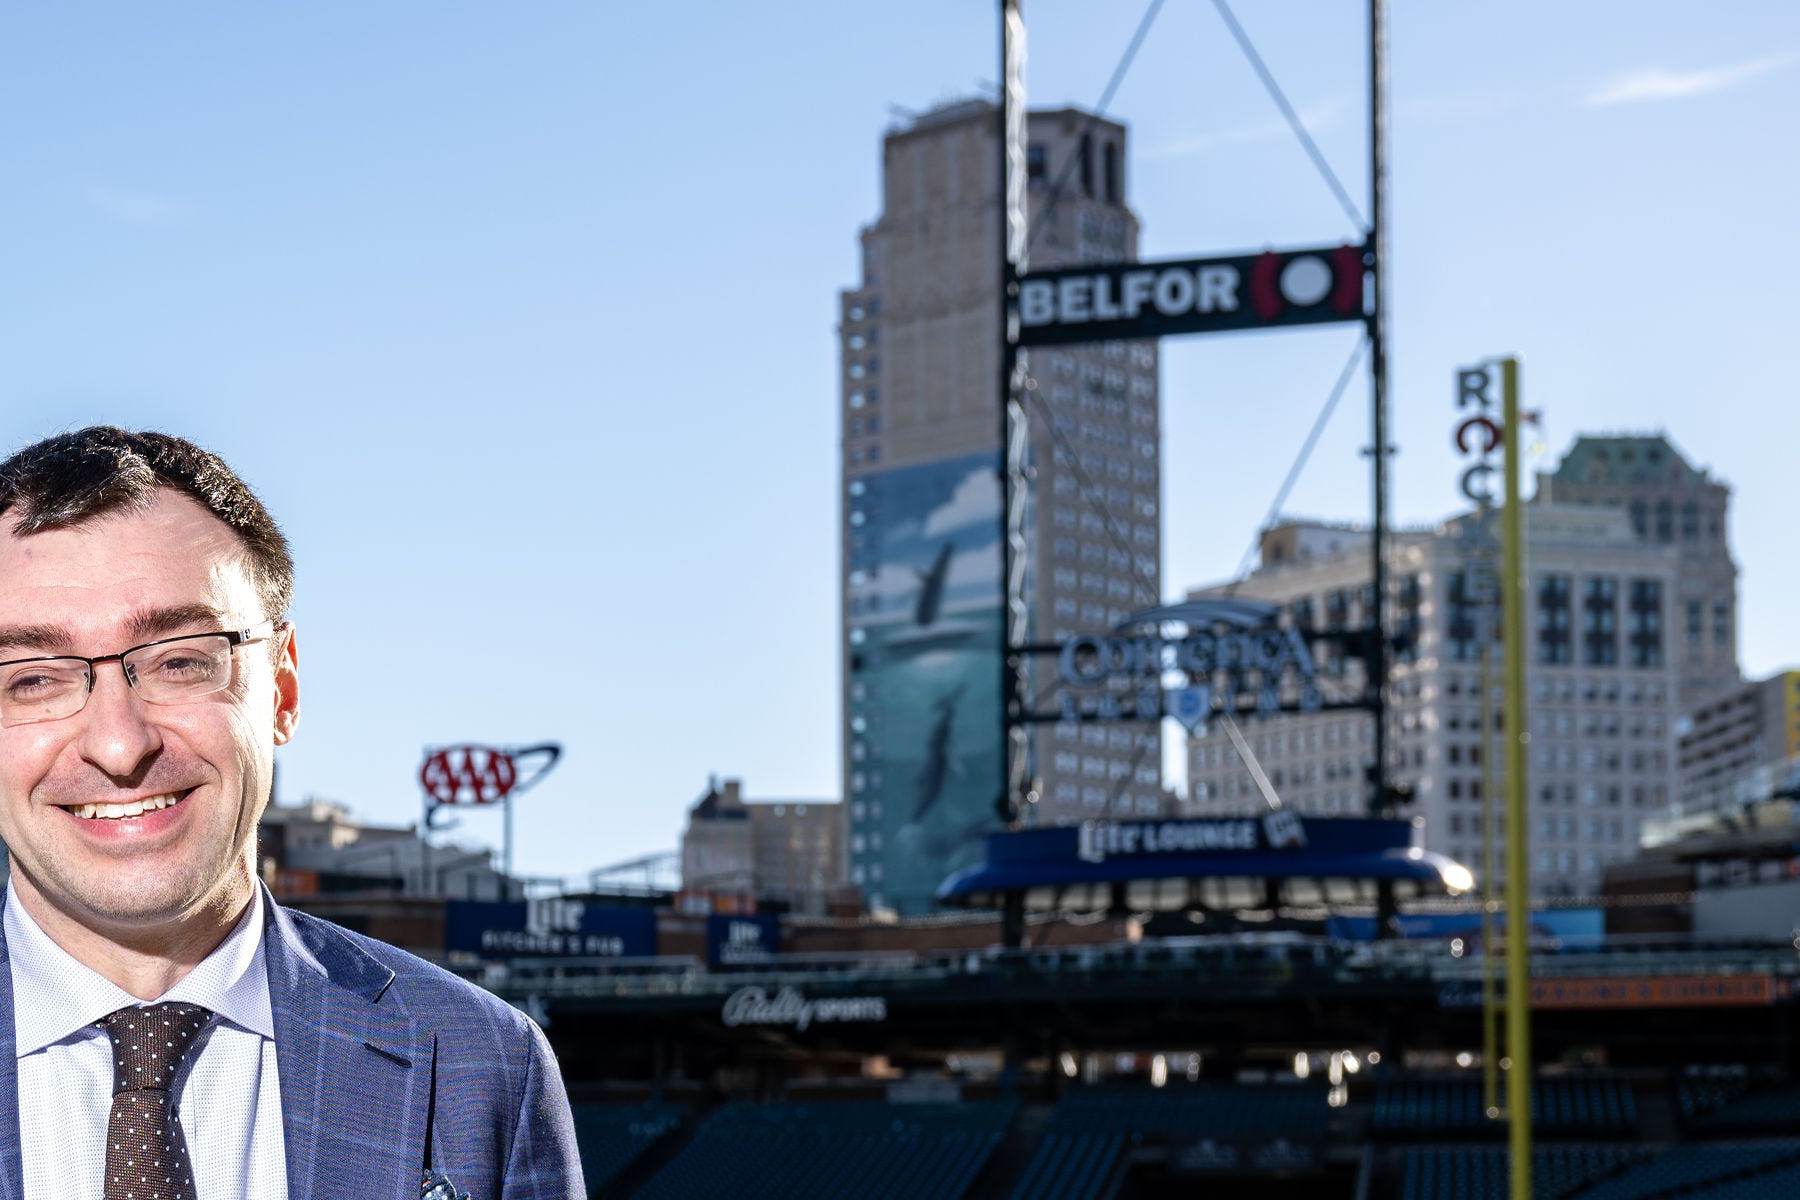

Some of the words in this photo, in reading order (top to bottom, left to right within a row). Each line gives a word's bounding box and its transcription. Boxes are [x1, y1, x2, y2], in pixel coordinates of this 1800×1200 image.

[1019, 263, 1240, 326] BELFOR
[422, 746, 517, 804] AAA
[721, 986, 813, 1031] Bally
[814, 997, 888, 1023] SPORTS
